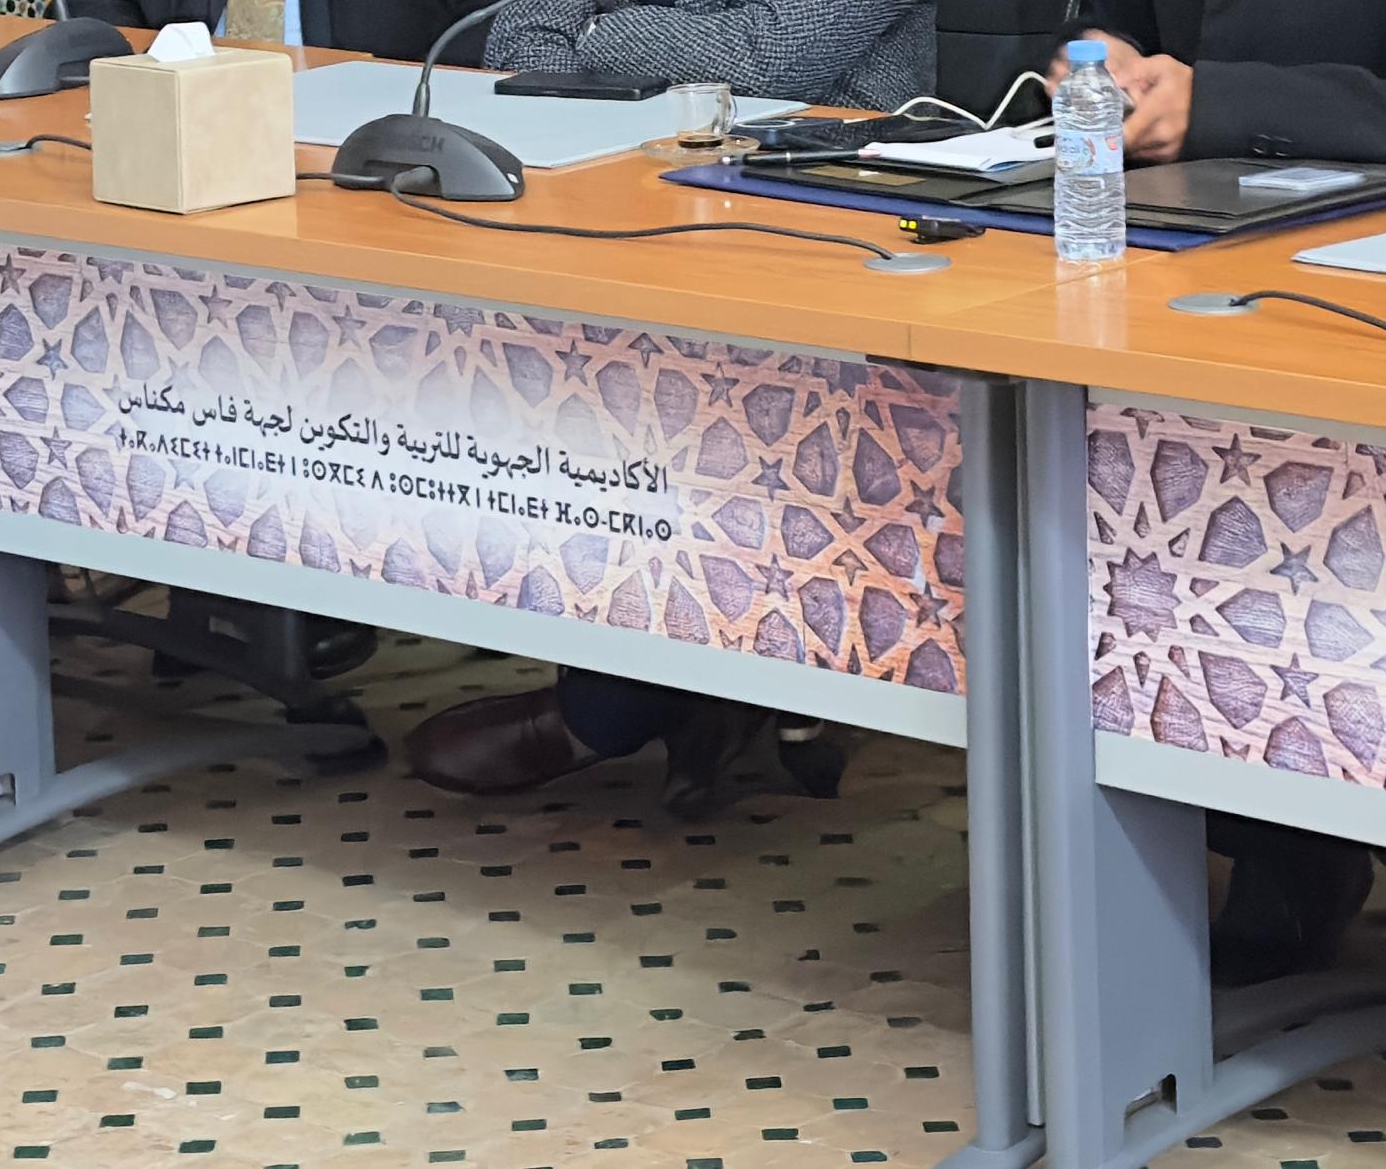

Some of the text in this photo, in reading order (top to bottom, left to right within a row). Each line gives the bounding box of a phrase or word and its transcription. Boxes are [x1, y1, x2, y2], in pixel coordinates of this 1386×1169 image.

[118, 383, 668, 494] الأكاديمية الجهوية للتربية والتكوين لجهة فاس مكناس
